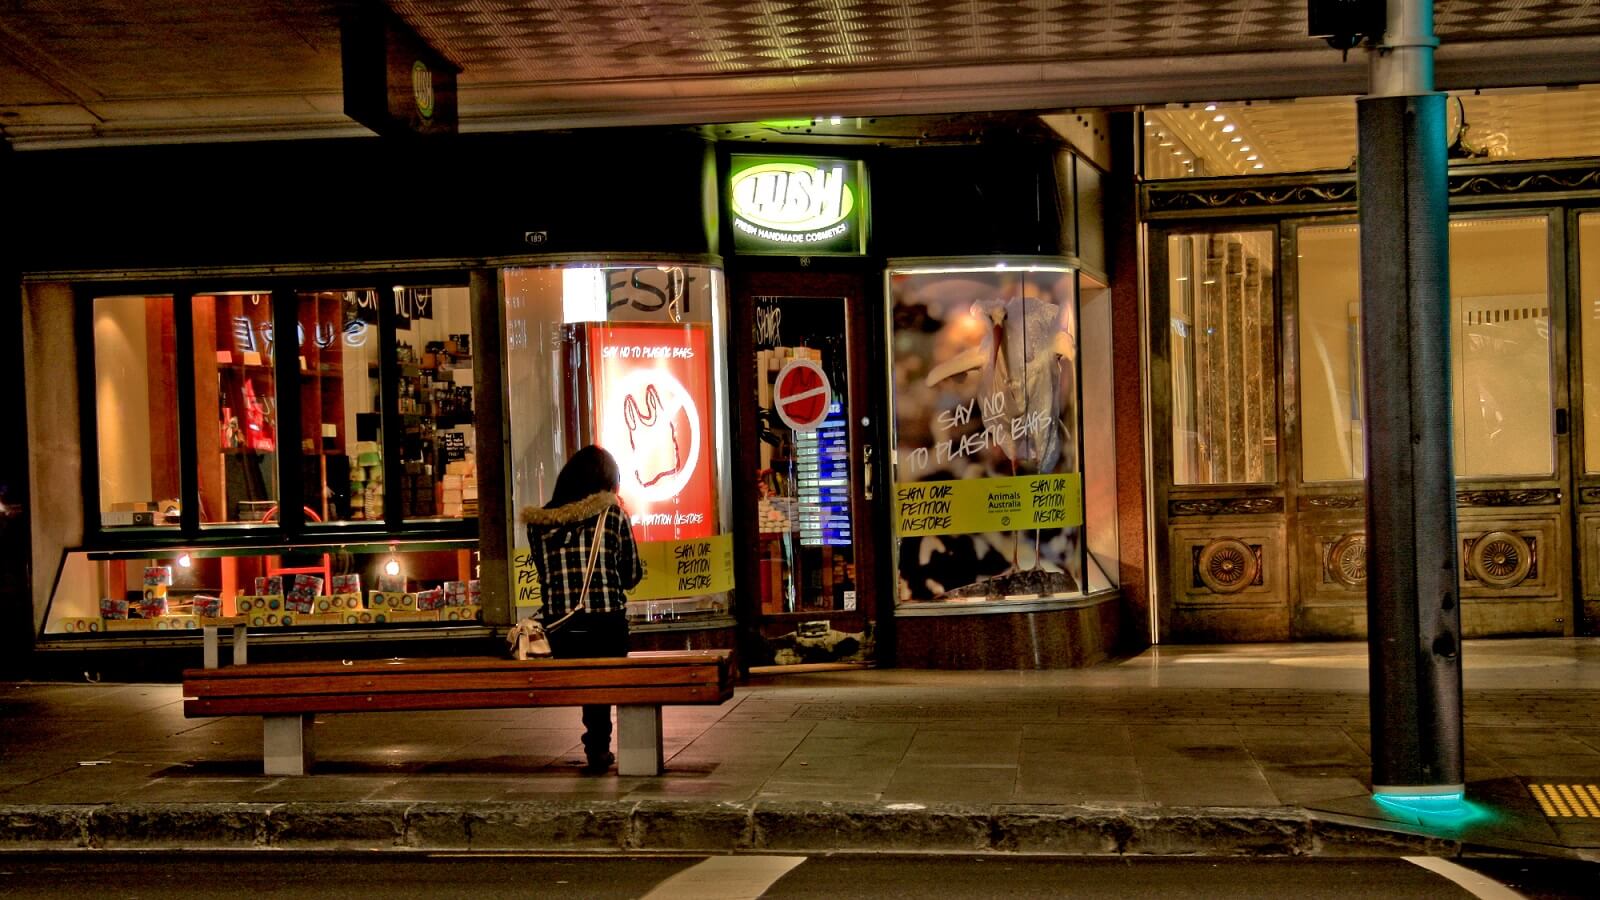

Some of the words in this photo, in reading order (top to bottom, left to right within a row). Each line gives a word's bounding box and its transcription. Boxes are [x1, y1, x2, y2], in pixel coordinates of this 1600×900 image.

[734, 218, 757, 235] FRESH
[758, 230, 804, 243] HANDMADE
[805, 223, 847, 243] COSMETICS
[603, 345, 619, 358] SAY
[620, 345, 630, 358] NO
[631, 345, 641, 358] TO
[642, 346, 671, 359] PLASTIC
[672, 347, 694, 360] BAGS
[937, 398, 975, 432] SAY
[983, 391, 1005, 417] NO
[907, 446, 929, 473] TO
[935, 424, 1008, 465] PLASTIC
[897, 486, 926, 501] SIGN
[929, 485, 953, 500] OUR
[1030, 480, 1050, 493] SIGN
[1053, 479, 1066, 491] OUR
[988, 491, 1021, 501] Animals
[1033, 493, 1066, 508] PETITION
[901, 501, 951, 517] PETITION
[988, 500, 1021, 509] Australia
[674, 512, 704, 525] INSTORE
[901, 516, 952, 531] INSTORE
[1033, 509, 1066, 523] INSTORE
[674, 543, 695, 559] SIGN
[698, 542, 711, 556] OUR
[677, 559, 710, 575] PETITION
[678, 575, 711, 591] INSTORE
